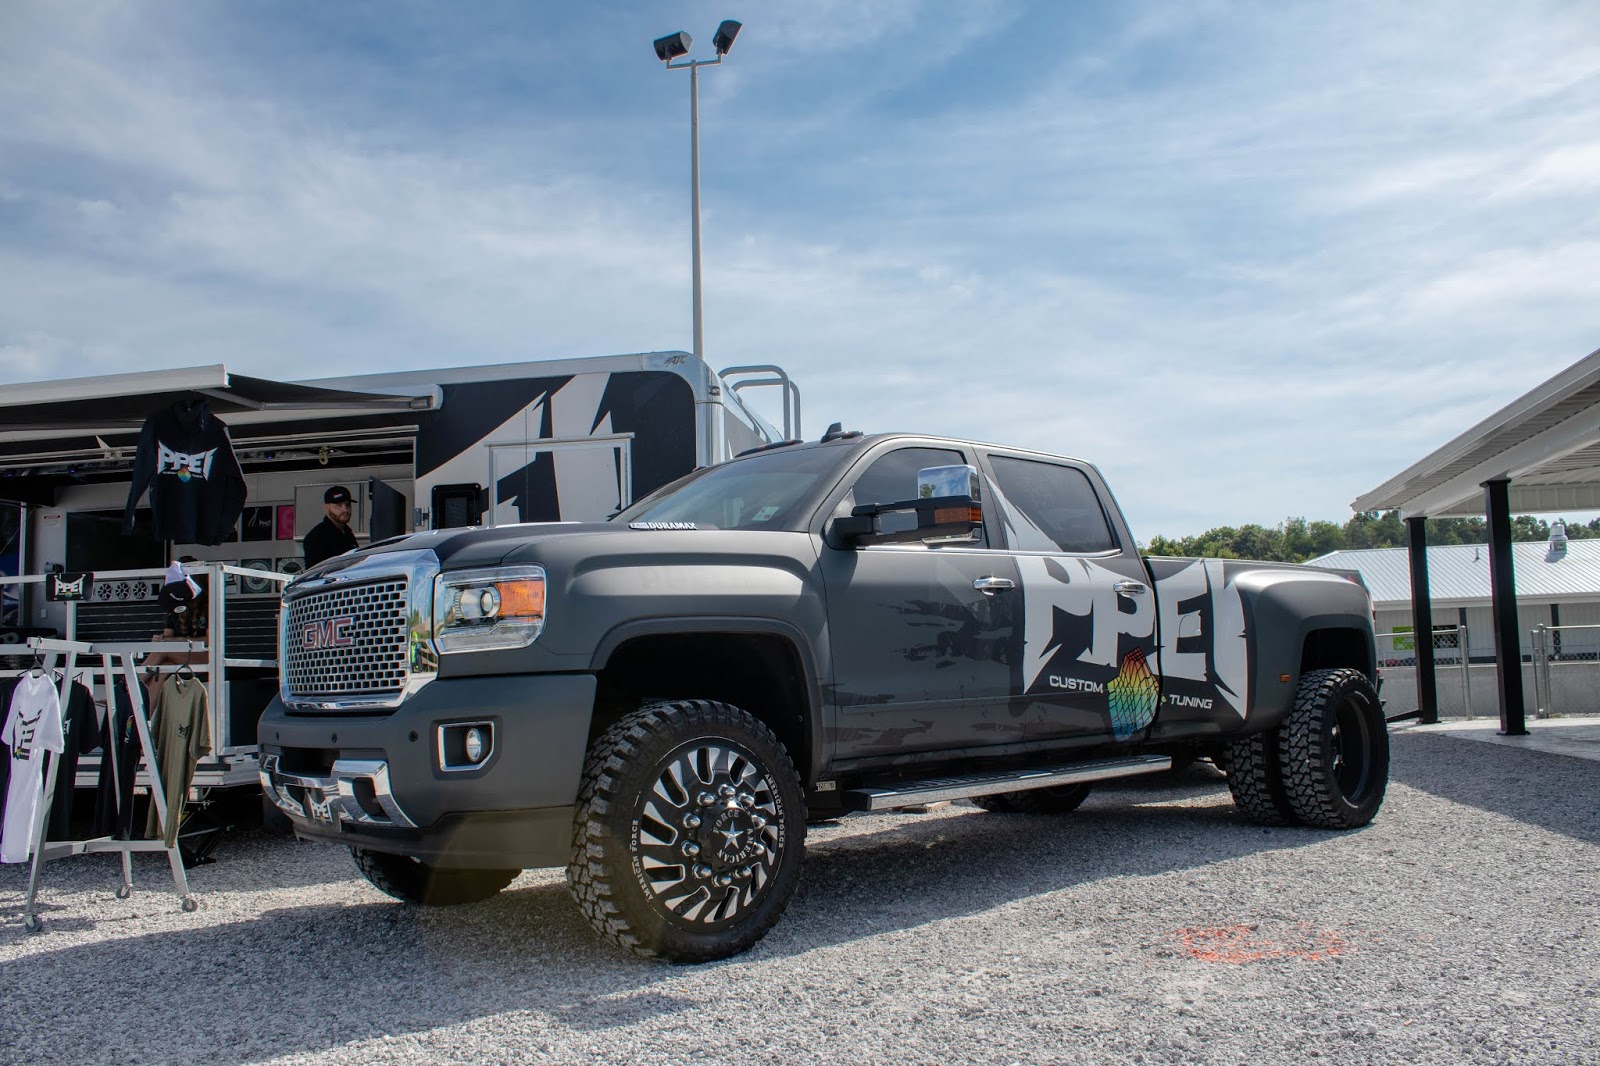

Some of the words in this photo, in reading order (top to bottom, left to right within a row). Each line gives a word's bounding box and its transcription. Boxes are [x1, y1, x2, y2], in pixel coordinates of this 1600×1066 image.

[157, 440, 218, 481] PPEI
[648, 522, 698, 531] DURAMAX
[984, 473, 1249, 721] PPEI
[302, 616, 355, 650] GMC
[1049, 675, 1104, 694] CUSTOM
[1169, 694, 1213, 710] TUNING
[712, 809, 740, 834] FORCE
